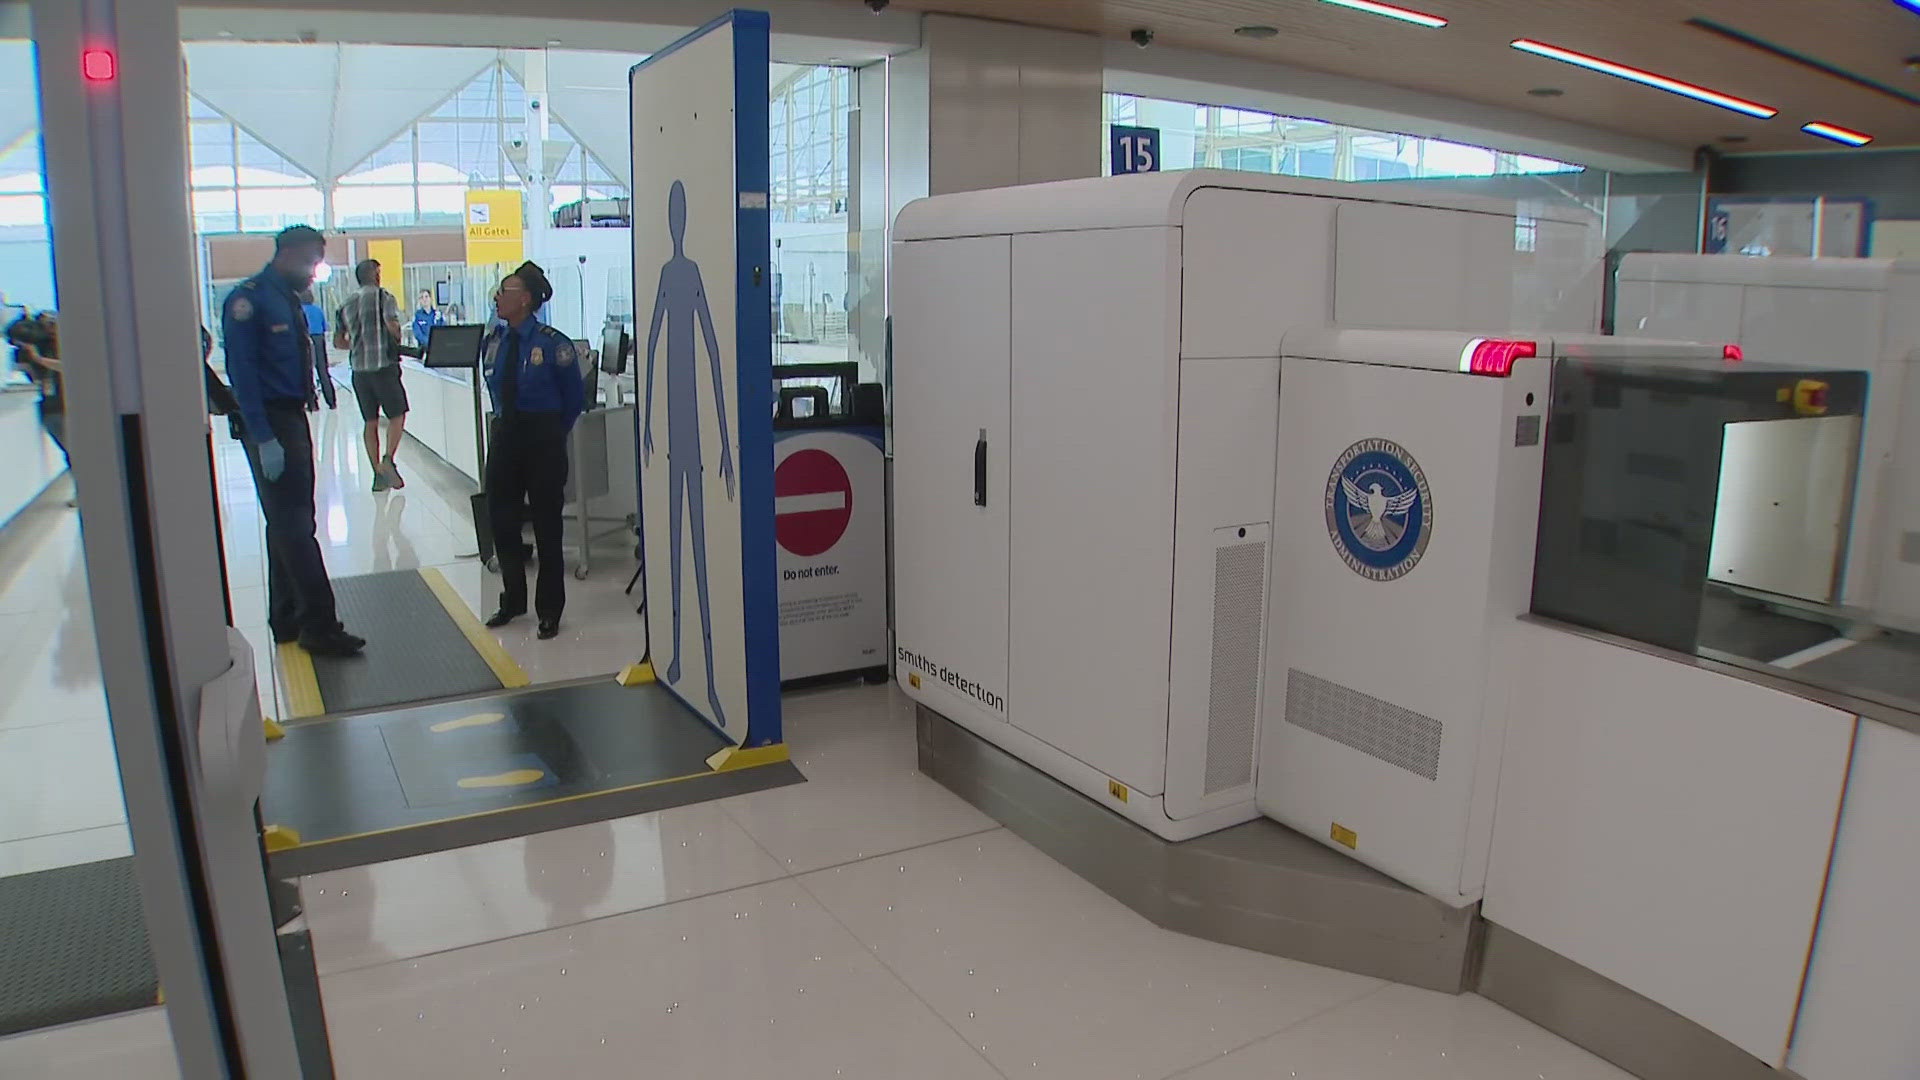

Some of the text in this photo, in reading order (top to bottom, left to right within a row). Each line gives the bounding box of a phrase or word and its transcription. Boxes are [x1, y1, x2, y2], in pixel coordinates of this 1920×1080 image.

[1120, 136, 1152, 172] 15
[469, 227, 510, 236] All Gates
[1326, 439, 1432, 529] TRANSPORTATION SECURITY
[783, 565, 840, 581] Do not enter.
[1330, 530, 1422, 581] ADMINISTRATION
[898, 646, 1004, 713] smiths detection
